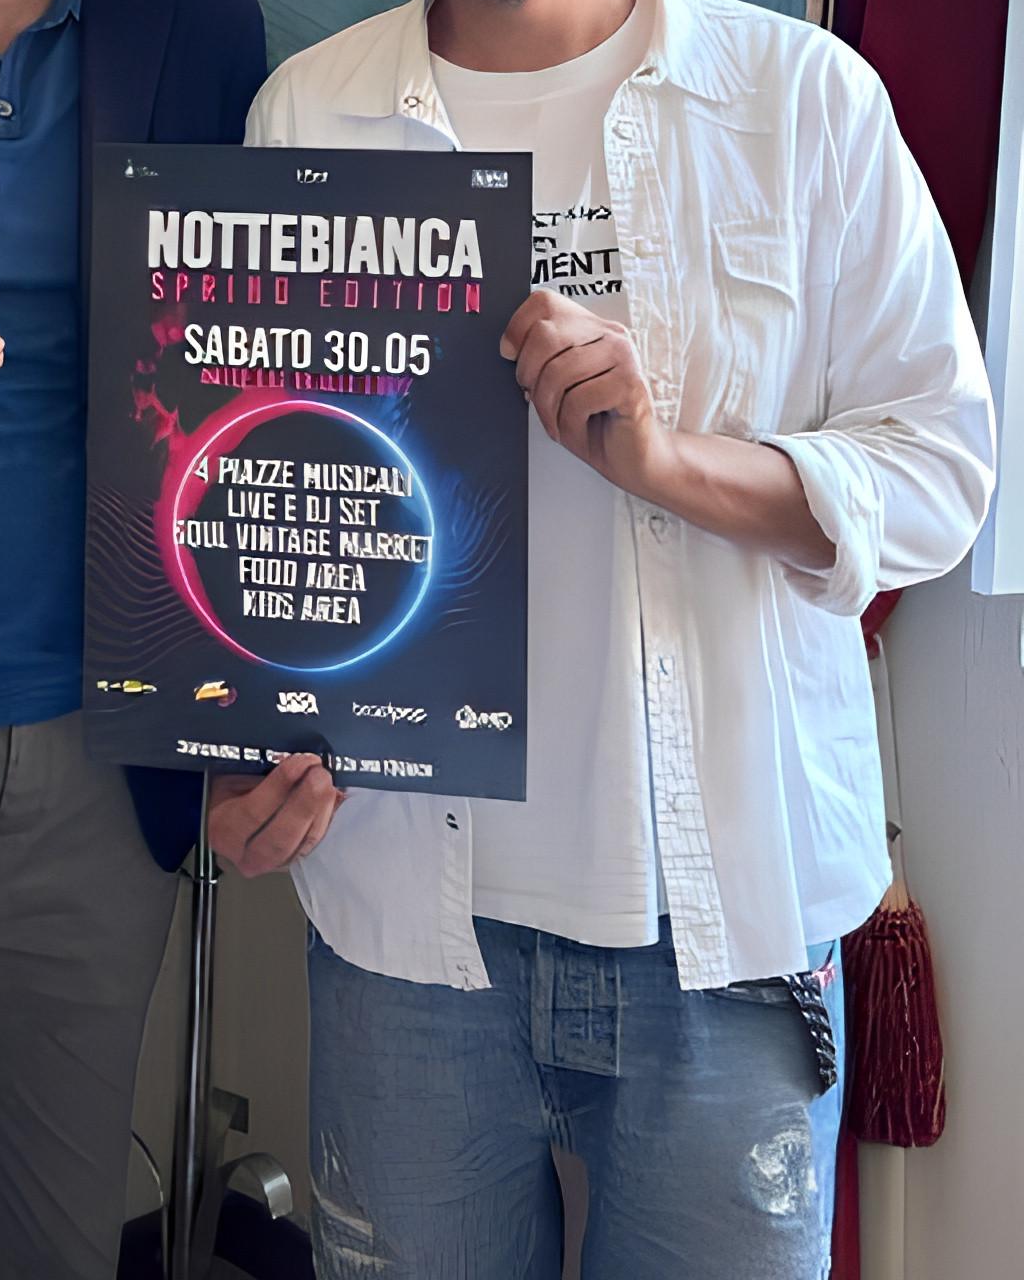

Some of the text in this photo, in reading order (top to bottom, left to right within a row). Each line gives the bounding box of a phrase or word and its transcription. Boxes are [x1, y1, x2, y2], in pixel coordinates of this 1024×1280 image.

[147, 209, 483, 279] NOTTEBIANCA
[183, 323, 431, 376] SABATO 30.05
[218, 456, 295, 488] PIAZZE
[227, 488, 381, 527] LIVE E DJ SET
[236, 522, 331, 557] VINTAGE
[238, 556, 367, 592] FOOD AREA
[300, 595, 361, 625] AREA
